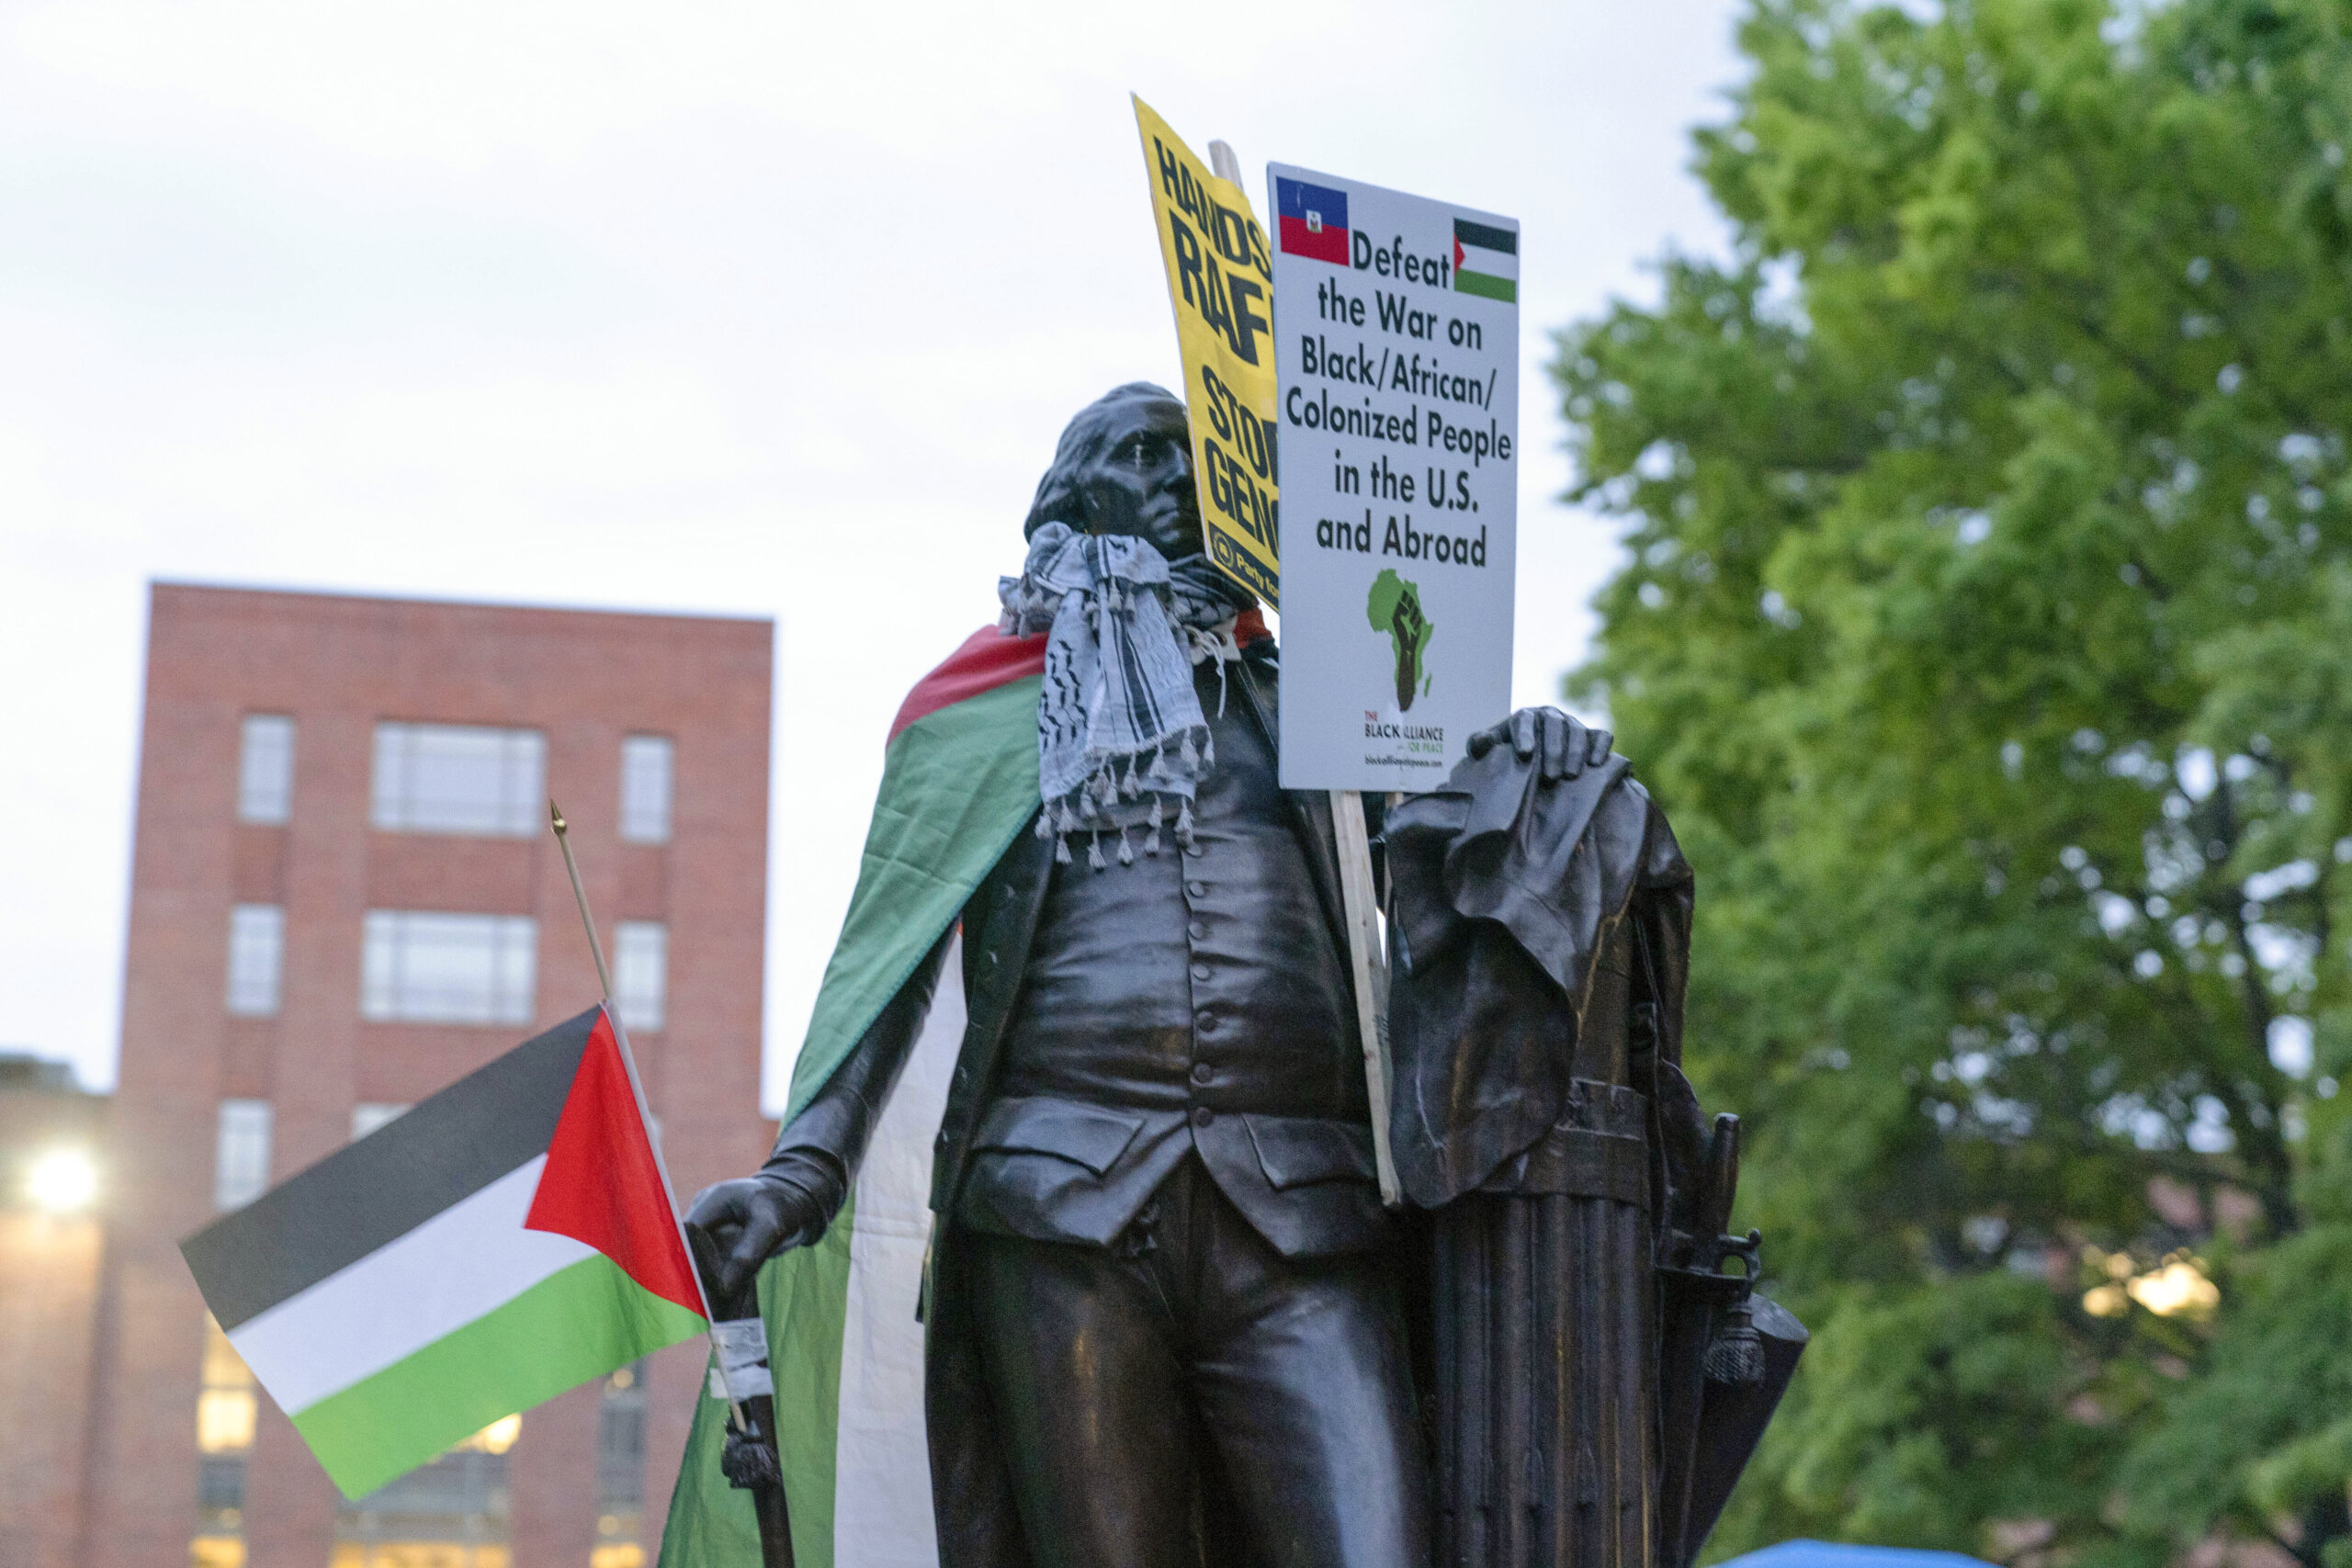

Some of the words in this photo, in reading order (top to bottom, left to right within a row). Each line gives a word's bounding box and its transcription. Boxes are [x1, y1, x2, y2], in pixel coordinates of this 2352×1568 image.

[1152, 134, 1274, 285] HANDS
[1169, 208, 1276, 367] RAF
[1352, 229, 1450, 289] Defeat
[1317, 276, 1366, 327] the
[1375, 288, 1438, 341] War
[1448, 318, 1482, 350] on
[1301, 333, 1498, 412] Black/African/
[1286, 386, 1418, 446] Colonized
[1428, 410, 1512, 468] People
[1204, 437, 1279, 562] GEN
[1335, 448, 1360, 495] in
[1371, 455, 1416, 503] the
[1427, 466, 1478, 513] U.S.
[1236, 552, 1265, 591] Party
[1317, 508, 1371, 553] and
[1382, 513, 1487, 568] Abroad
[1365, 723, 1400, 739] BLACK
